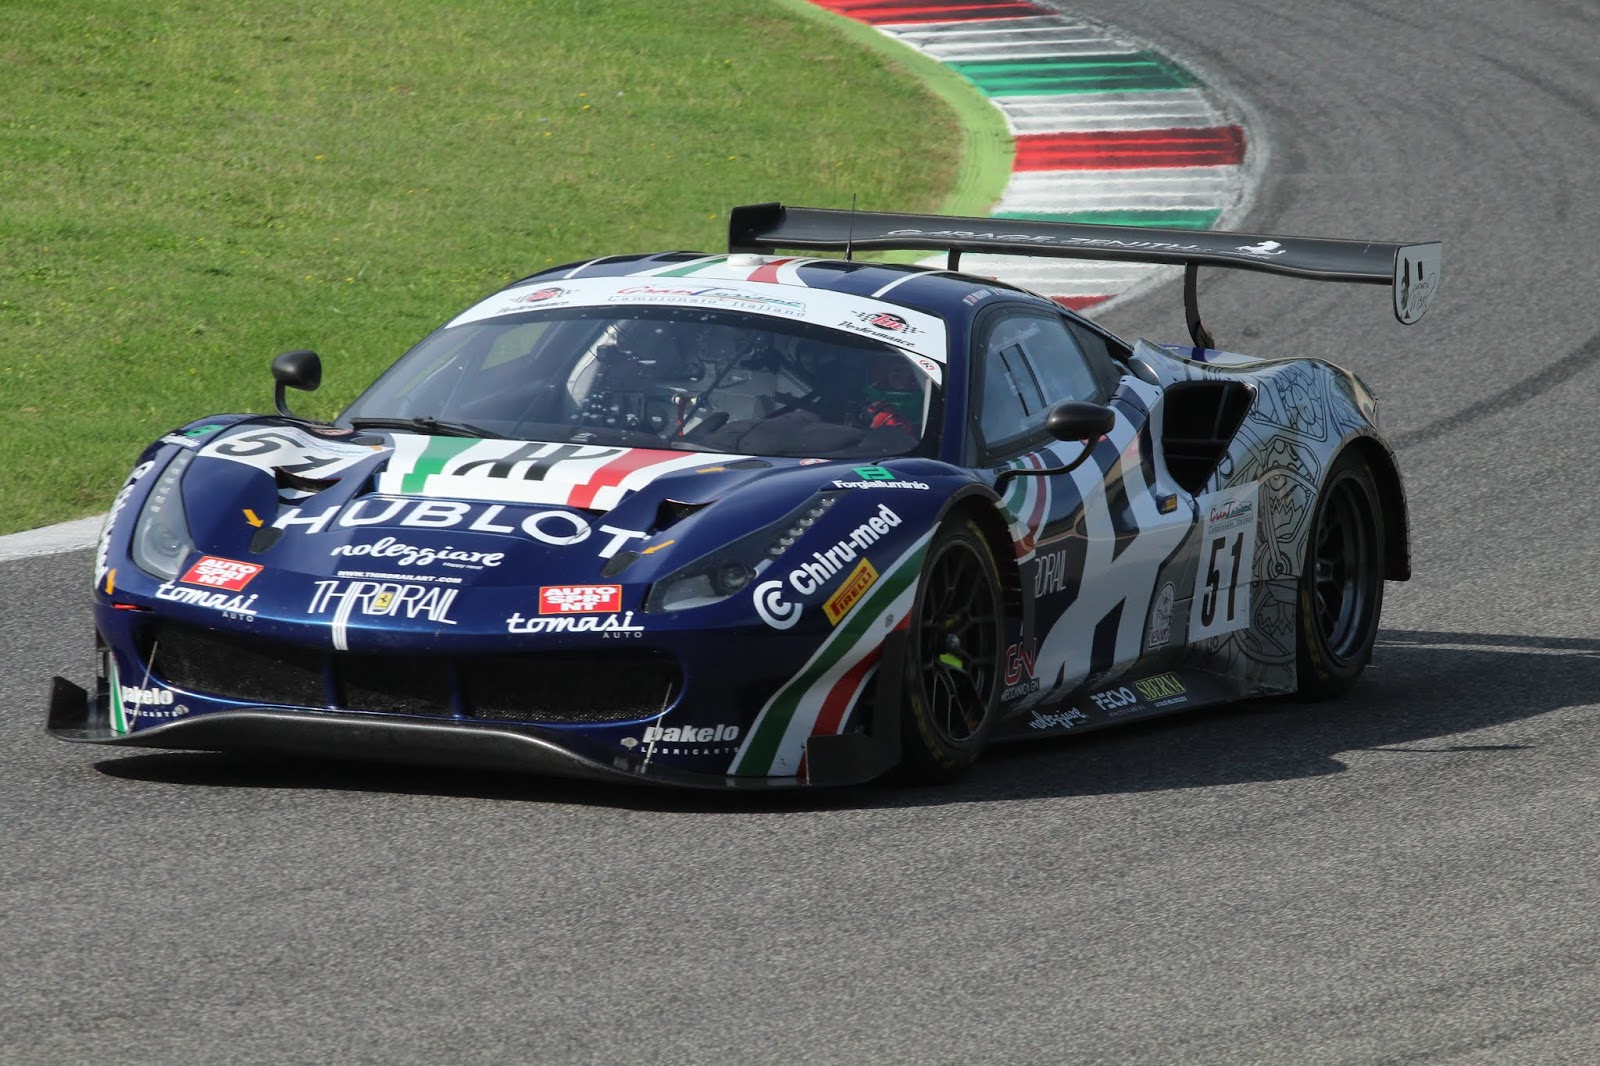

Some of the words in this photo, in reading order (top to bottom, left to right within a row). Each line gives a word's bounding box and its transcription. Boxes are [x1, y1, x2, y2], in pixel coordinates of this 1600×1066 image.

[608, 295, 717, 305] Campionato
[733, 301, 806, 317] Italiano
[831, 479, 930, 491] Forgialluminio
[272, 500, 647, 560] HUBLOT
[330, 536, 505, 567] noleggiare
[789, 503, 903, 596] Chiru-med
[194, 567, 247, 581] SPRI
[198, 559, 258, 574] AUTO
[197, 575, 231, 586] NT
[1201, 532, 1244, 627] 51
[155, 579, 259, 616] tomasi
[543, 587, 618, 596] AUTO
[547, 594, 612, 604] SPRI
[829, 565, 873, 619] PIRELLI
[221, 611, 254, 622] AUTO
[561, 602, 598, 612] NT
[506, 610, 645, 633] tomasi
[602, 631, 643, 639] AUTO
[1135, 674, 1185, 700] SBERNA
[642, 724, 740, 743] pakelo
